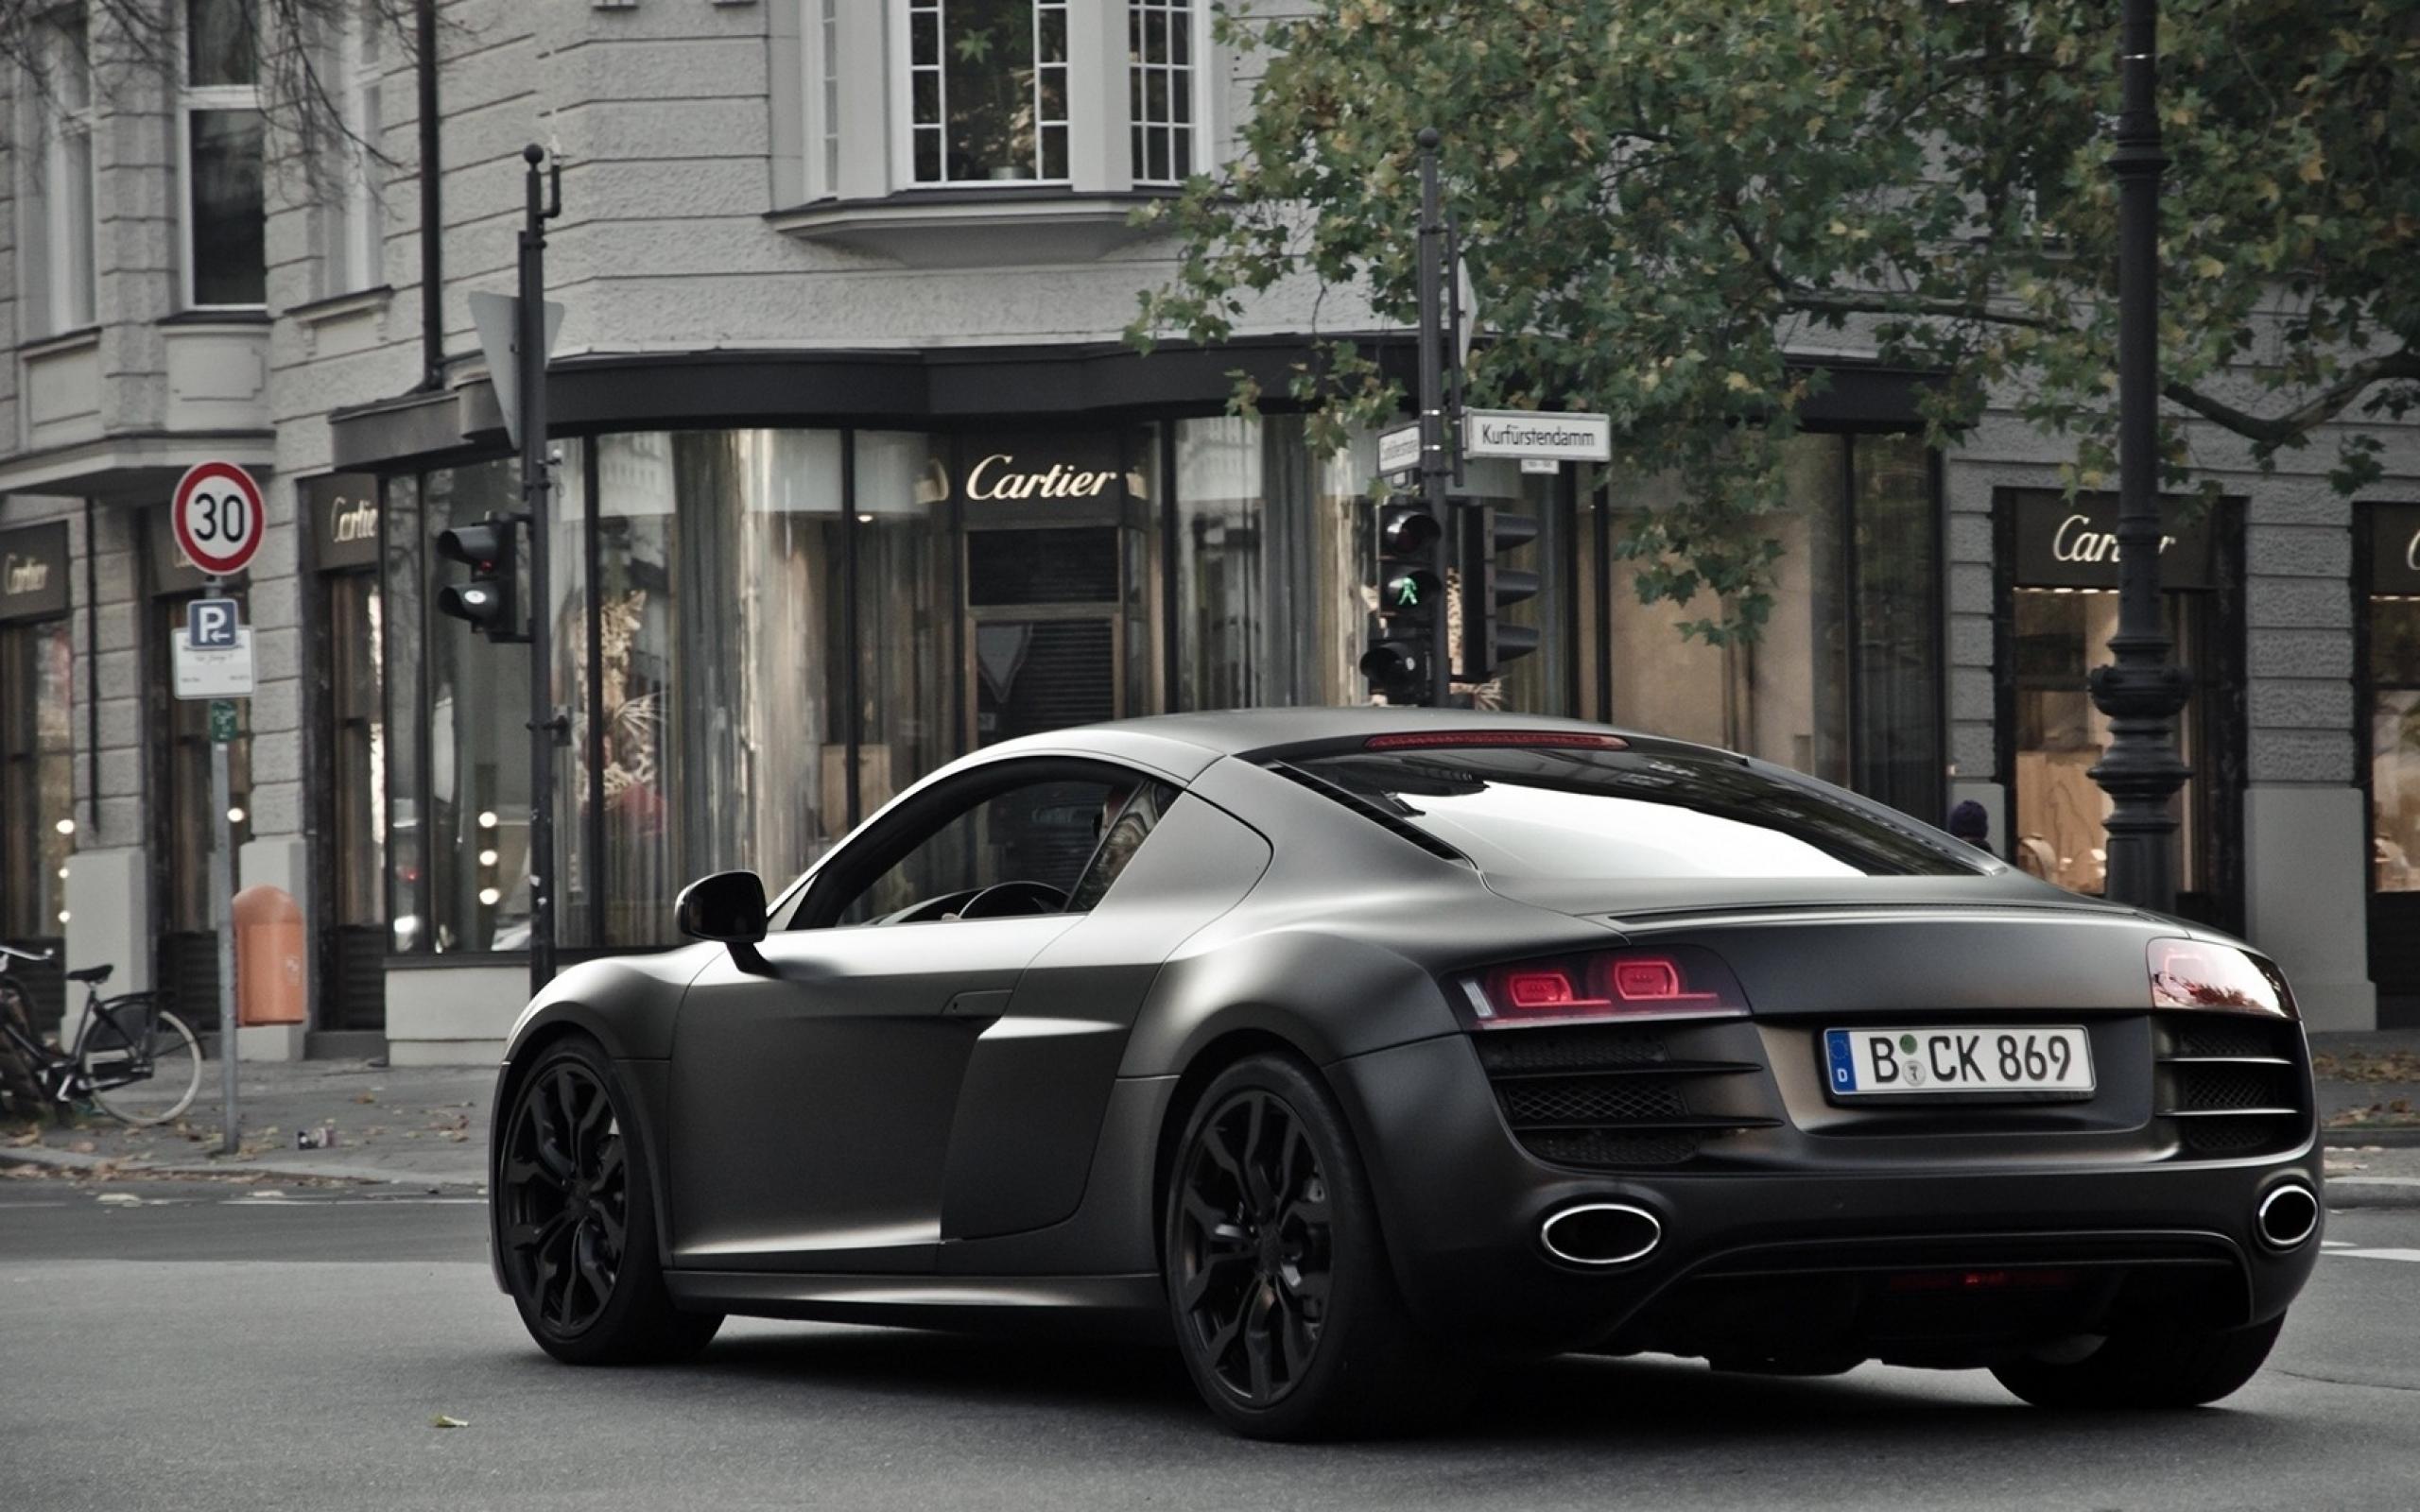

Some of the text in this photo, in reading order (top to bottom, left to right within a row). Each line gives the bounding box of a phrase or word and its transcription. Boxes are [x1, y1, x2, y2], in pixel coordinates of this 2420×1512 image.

[1482, 424, 1595, 447] Kurfürstendamm
[966, 454, 1117, 500] Cartier
[194, 493, 245, 543] 30
[331, 496, 378, 542] Cartie
[2053, 514, 2176, 562] Carr
[199, 607, 226, 643] P
[1838, 1068, 1848, 1083] D
[1869, 1034, 2072, 1083] B CK 869
